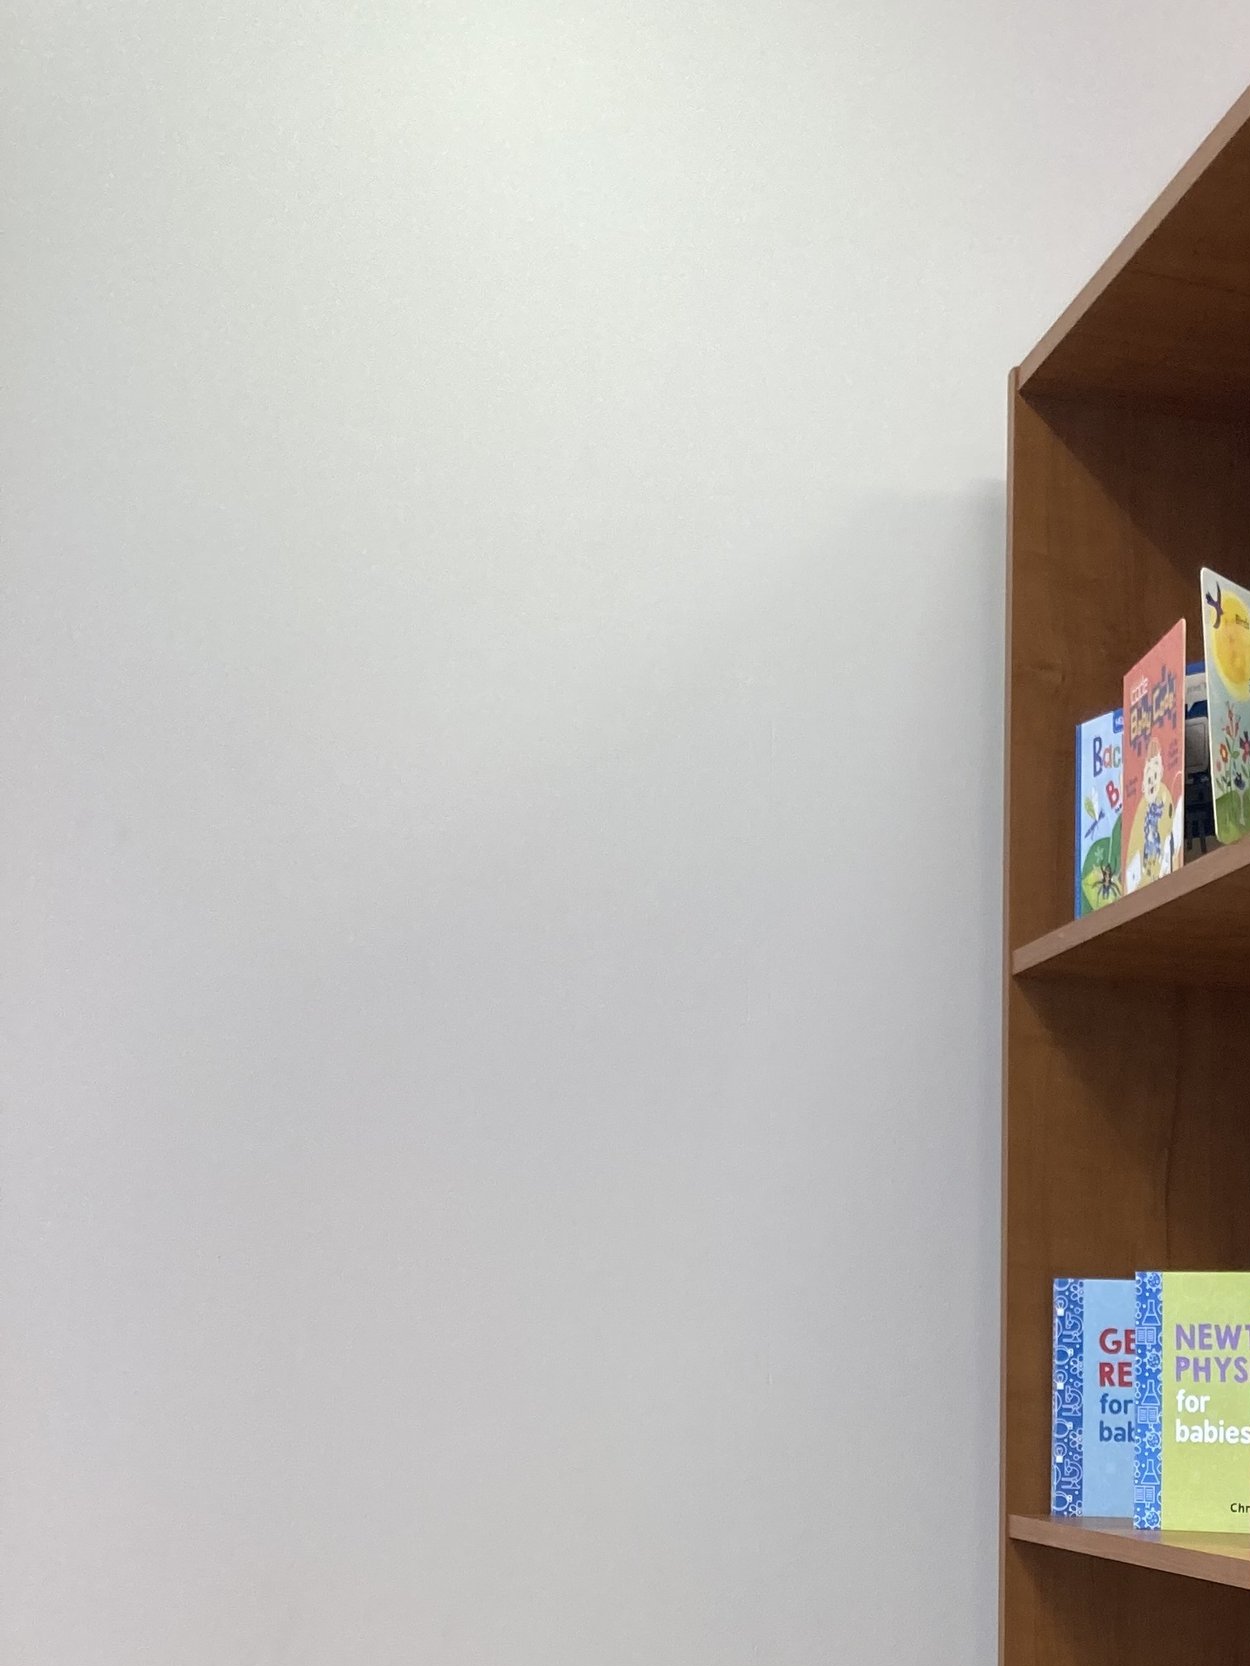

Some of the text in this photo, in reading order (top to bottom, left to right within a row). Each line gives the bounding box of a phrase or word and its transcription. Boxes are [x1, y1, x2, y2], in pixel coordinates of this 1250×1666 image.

[1093, 736, 1122, 778] Bac
[1100, 1392, 1133, 1414] for
[1176, 1389, 1210, 1413] for
